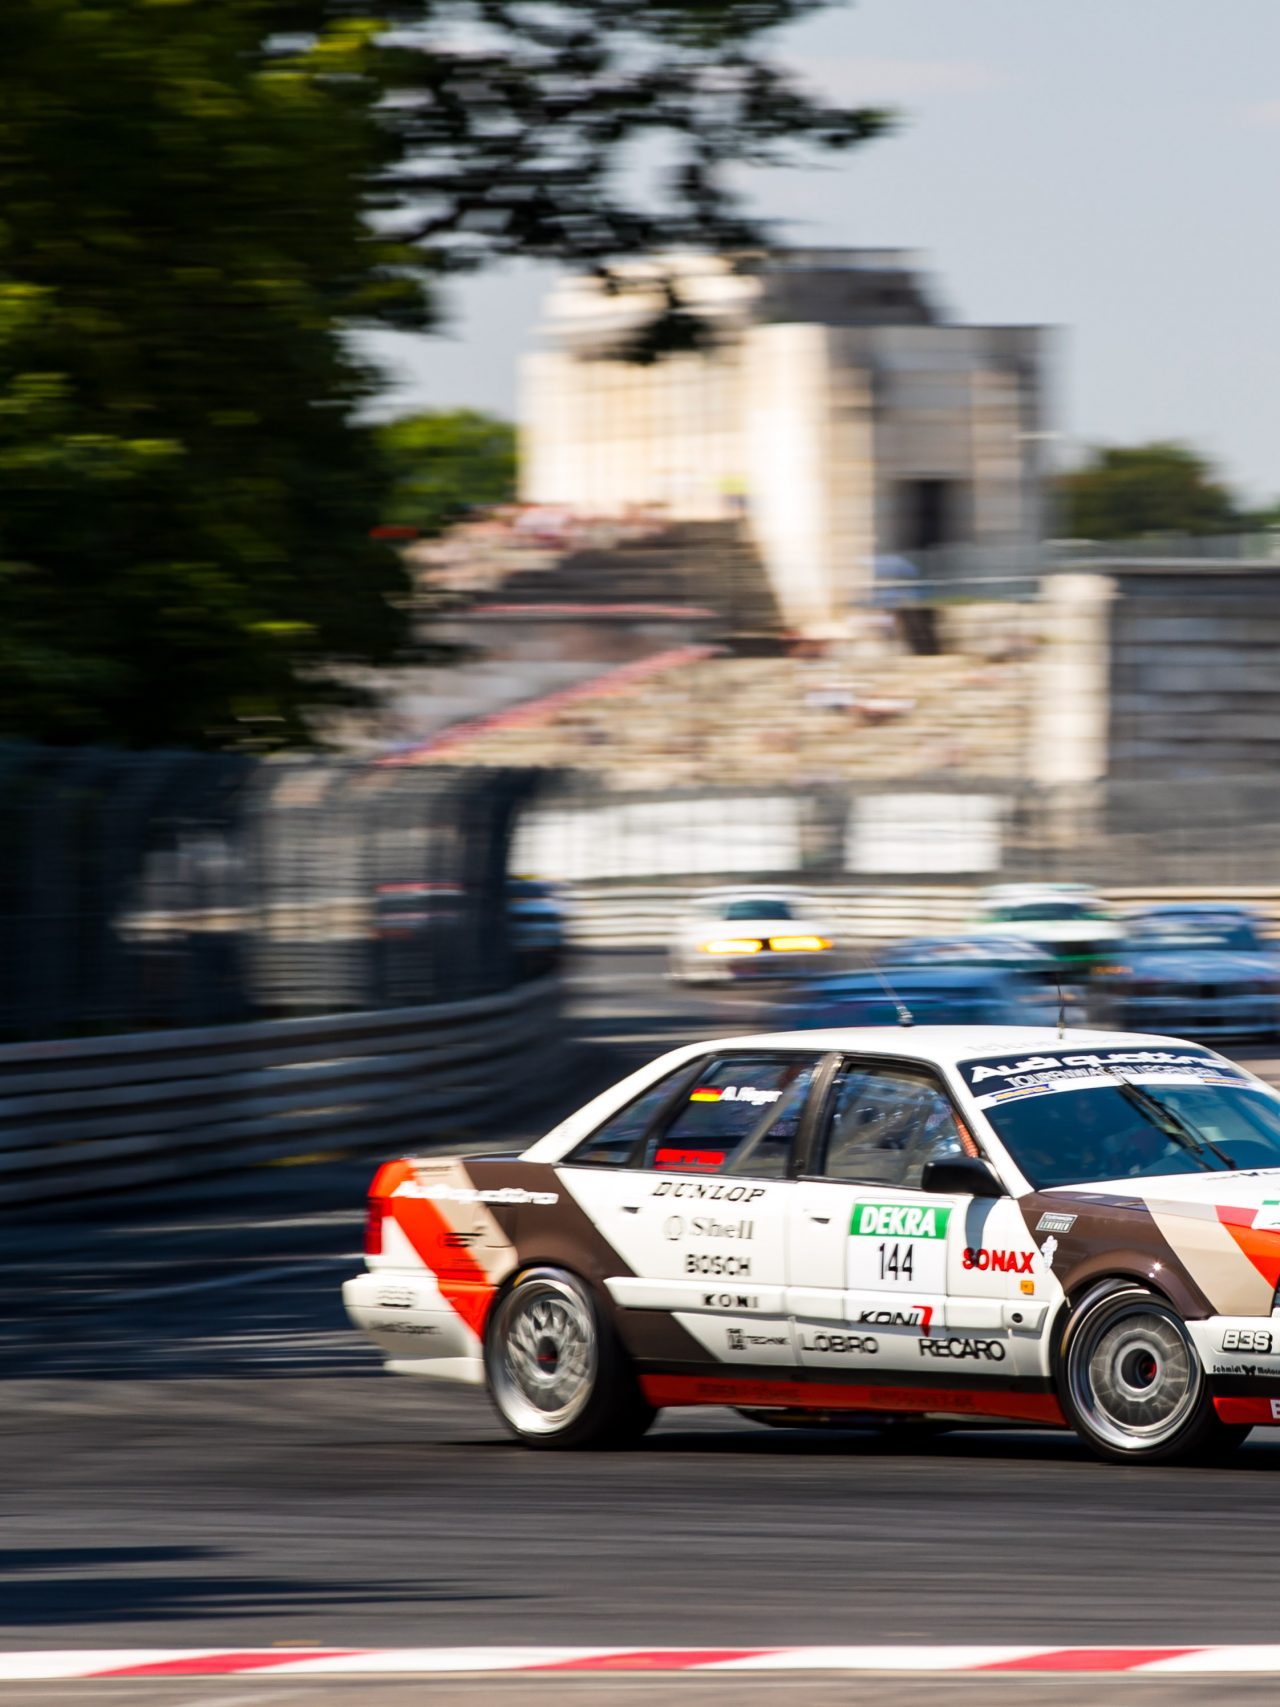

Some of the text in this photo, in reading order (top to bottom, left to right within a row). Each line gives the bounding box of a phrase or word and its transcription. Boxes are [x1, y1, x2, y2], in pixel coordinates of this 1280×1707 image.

[652, 1182, 766, 1203] DUNLOP
[690, 1216, 755, 1240] Shell
[859, 1206, 937, 1237] DEKRA
[686, 1253, 752, 1276] BOSCH
[878, 1243, 914, 1281] 144
[962, 1247, 1035, 1274] SONAX
[702, 1293, 760, 1308] KONI
[859, 1310, 920, 1327] KONI
[918, 1338, 1006, 1361] RECARO
